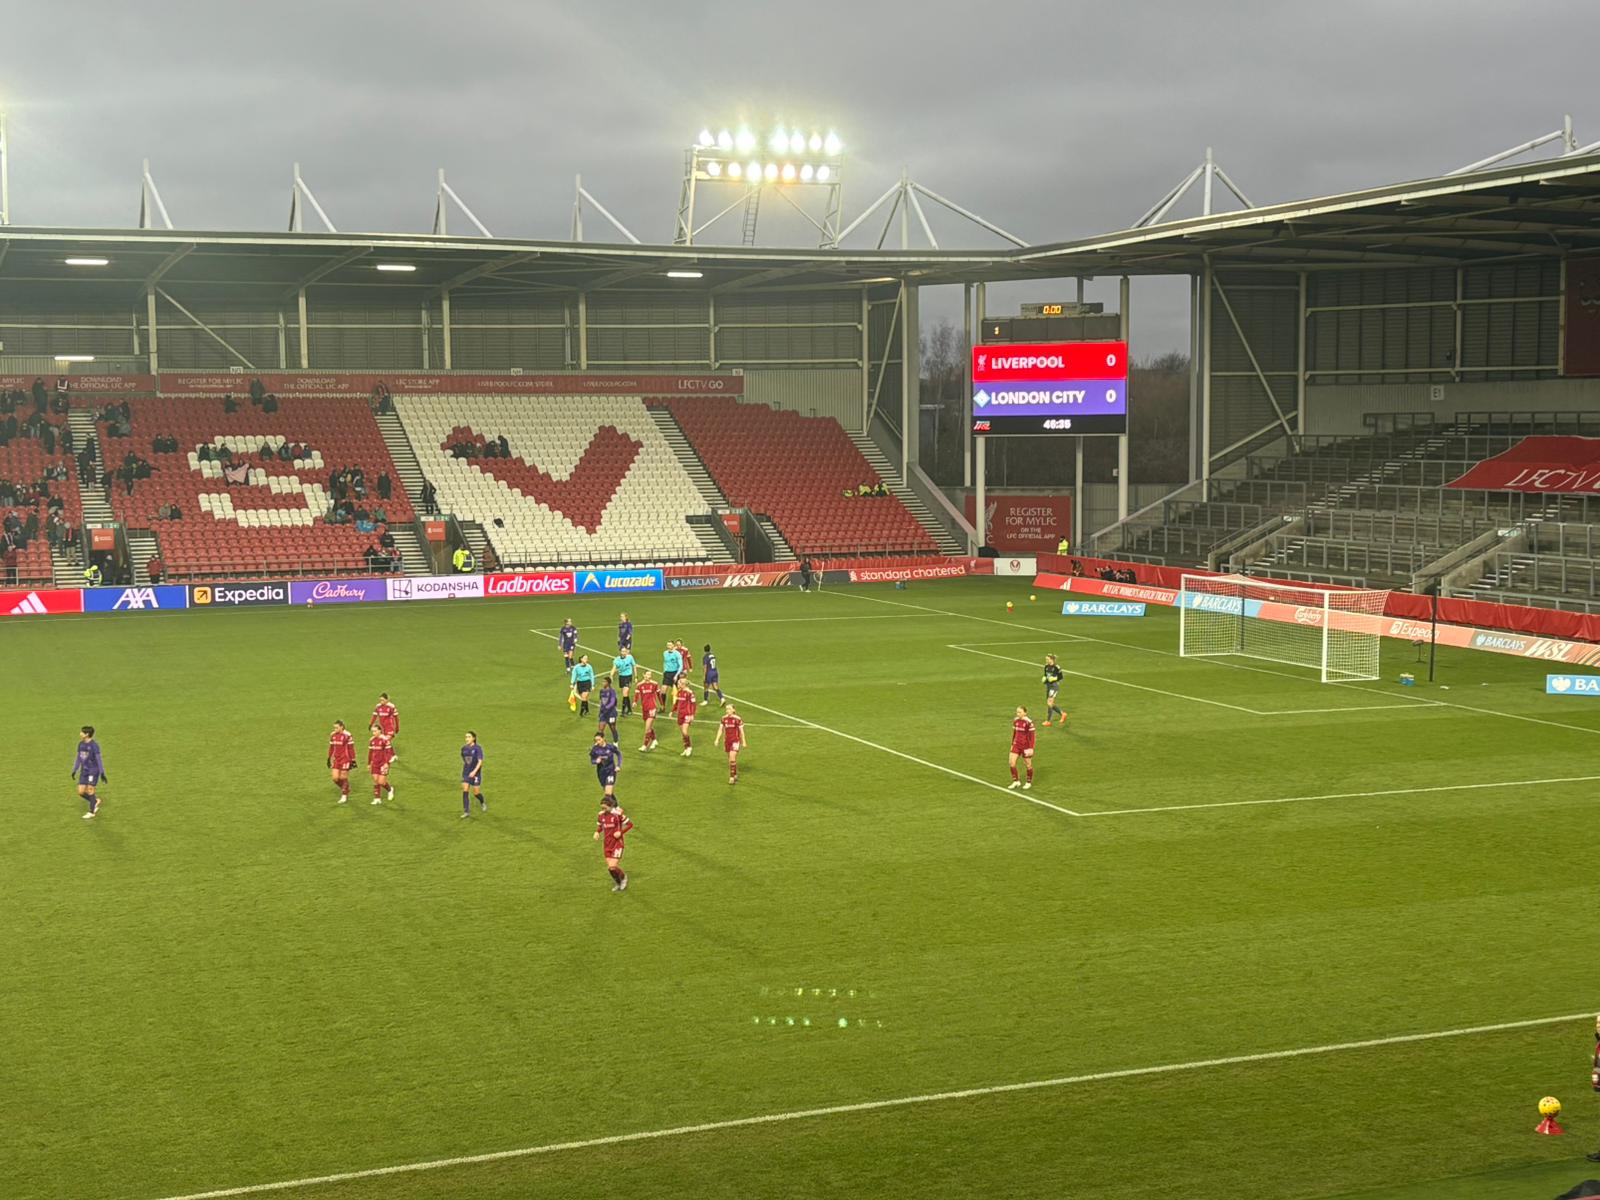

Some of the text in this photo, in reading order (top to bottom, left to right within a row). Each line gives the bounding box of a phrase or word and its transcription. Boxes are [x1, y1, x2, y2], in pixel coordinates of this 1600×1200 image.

[991, 354, 1116, 369] LIVERPOOL 0
[708, 380, 724, 389] GO
[991, 389, 1117, 405] LONDON CITY 0
[1010, 507, 1053, 516] REGISTER
[1005, 517, 1057, 525] FOR MYLFC
[605, 572, 656, 588] Lucozade
[680, 573, 764, 587] BARCLAYS WSL
[860, 565, 966, 580] standard chartered
[313, 581, 365, 600] Cadbury
[417, 582, 479, 592] KODANSHA
[488, 576, 570, 594] Ladbrokes
[112, 588, 159, 610] AXA
[215, 587, 283, 604] Expedia
[1081, 603, 1141, 613] BARCLAYS
[1200, 596, 1241, 612] BARCLAYS
[1484, 637, 1574, 661] BARCLAYS WSL
[1575, 679, 1600, 690] BA
